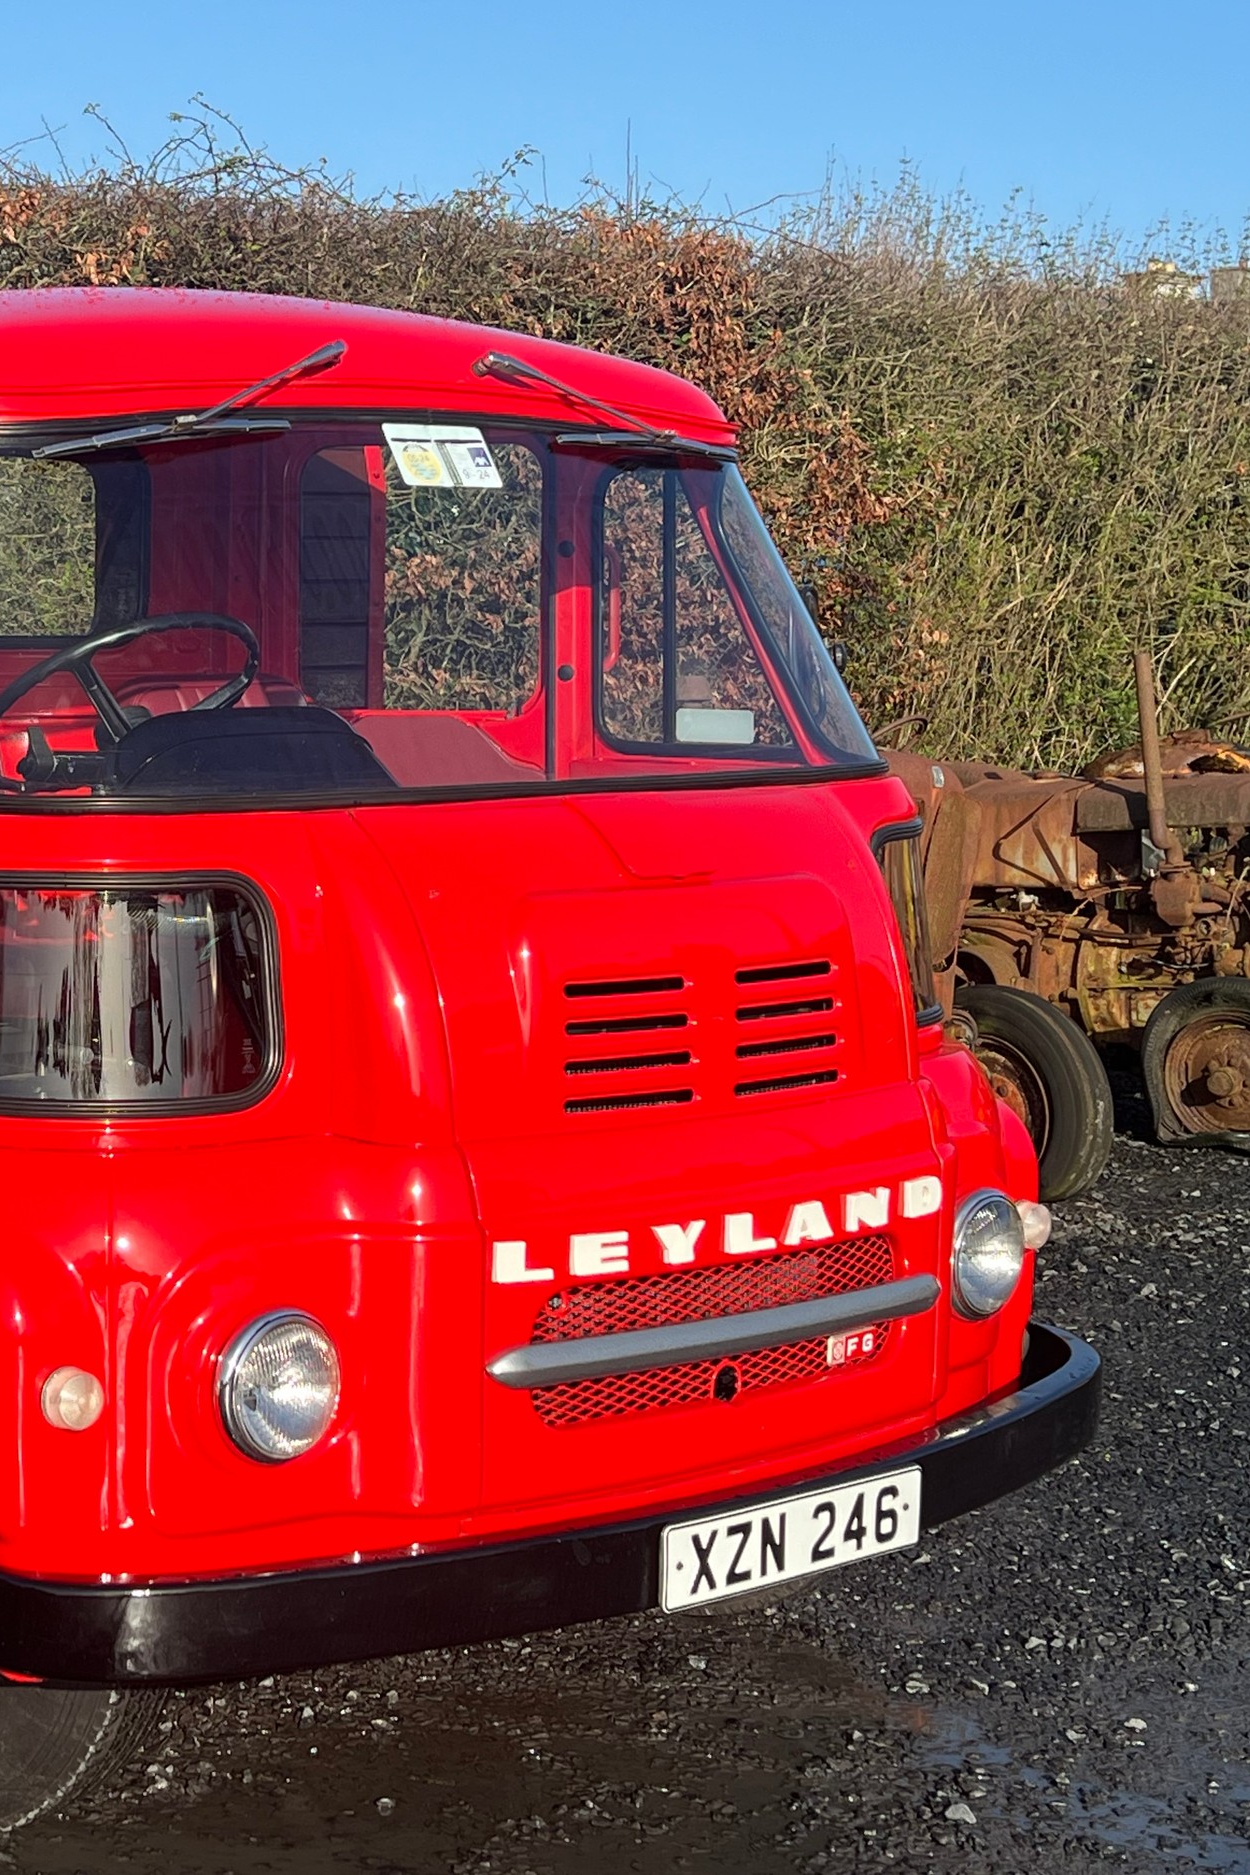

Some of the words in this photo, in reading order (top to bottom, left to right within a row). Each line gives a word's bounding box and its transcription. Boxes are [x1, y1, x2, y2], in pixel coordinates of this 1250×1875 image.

[491, 1175, 943, 1284] LEYLAND
[846, 1332, 875, 1357] FG
[690, 1512, 787, 1597] XZN
[811, 1485, 900, 1563] 246
